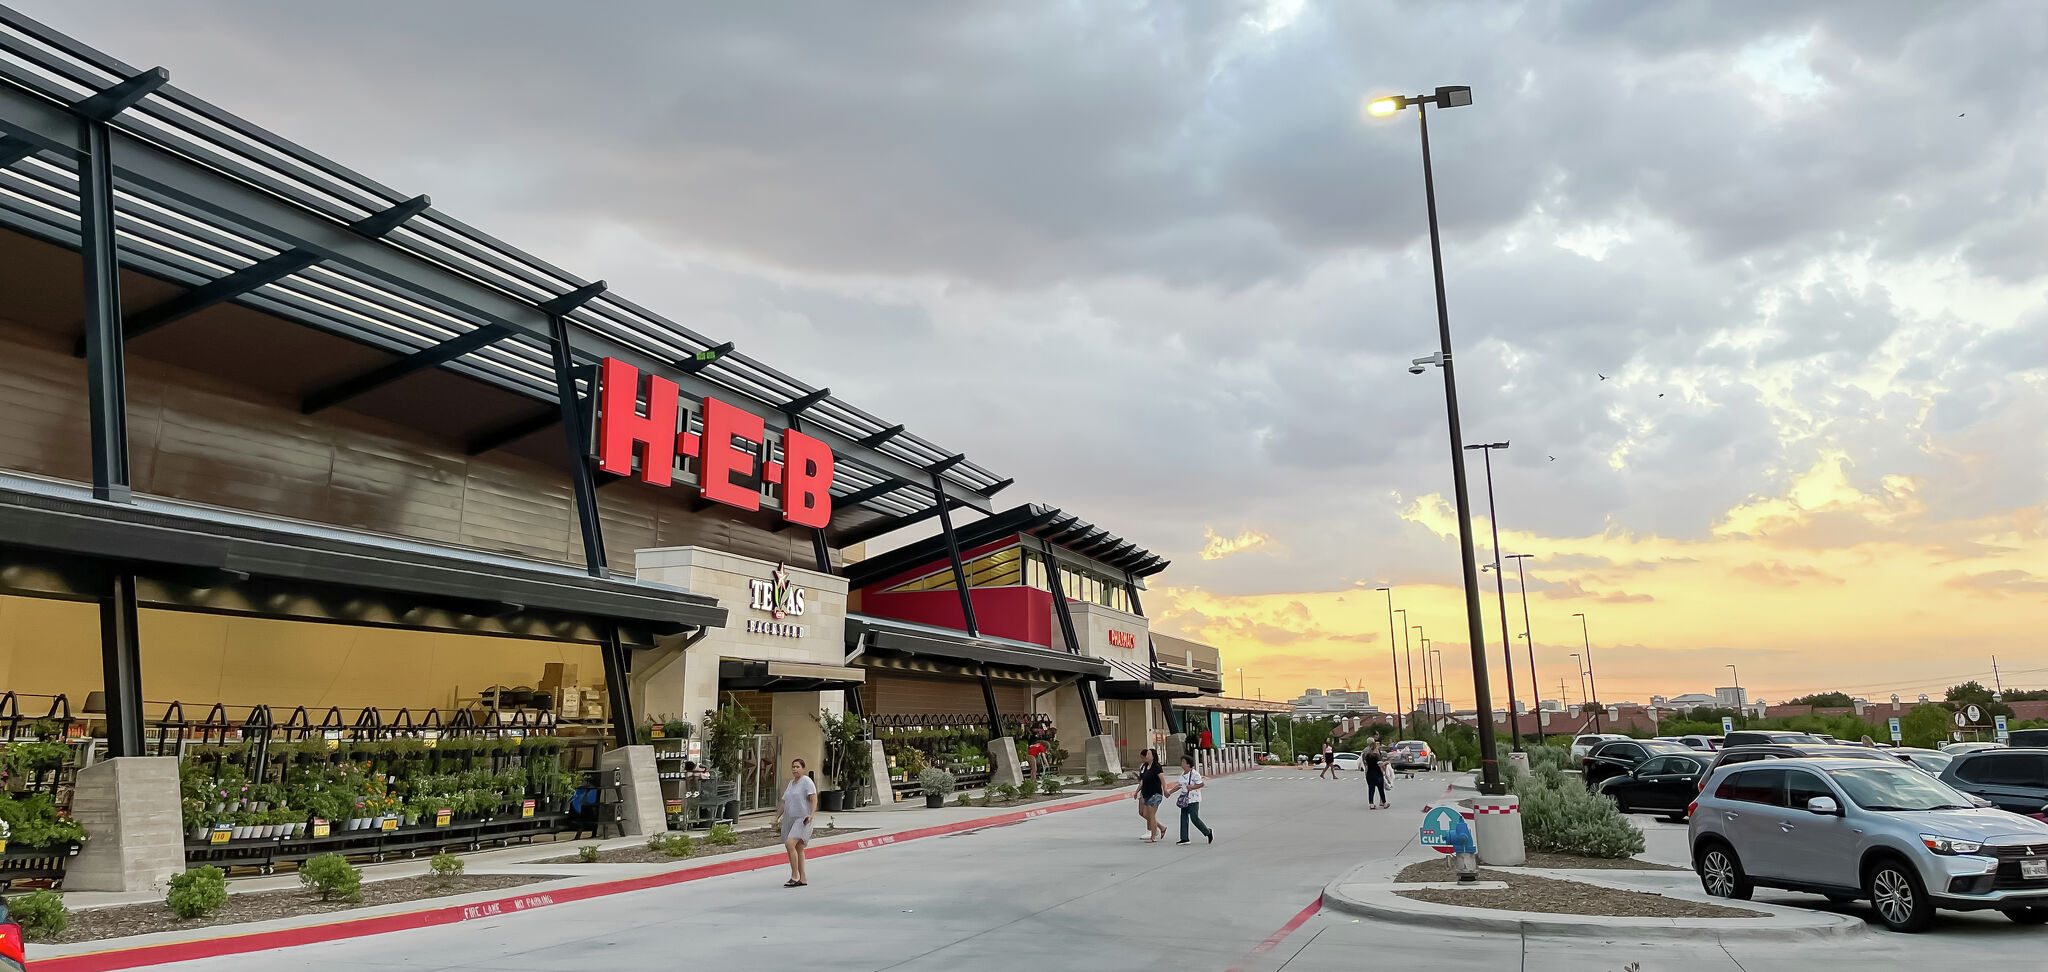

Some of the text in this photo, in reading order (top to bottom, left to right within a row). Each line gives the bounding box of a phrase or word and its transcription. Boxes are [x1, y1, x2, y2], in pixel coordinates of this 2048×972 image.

[749, 578, 805, 616] TEXAS
[747, 620, 804, 638] BACKYARD
[464, 894, 553, 919] FIRE LANE NO PARKING
